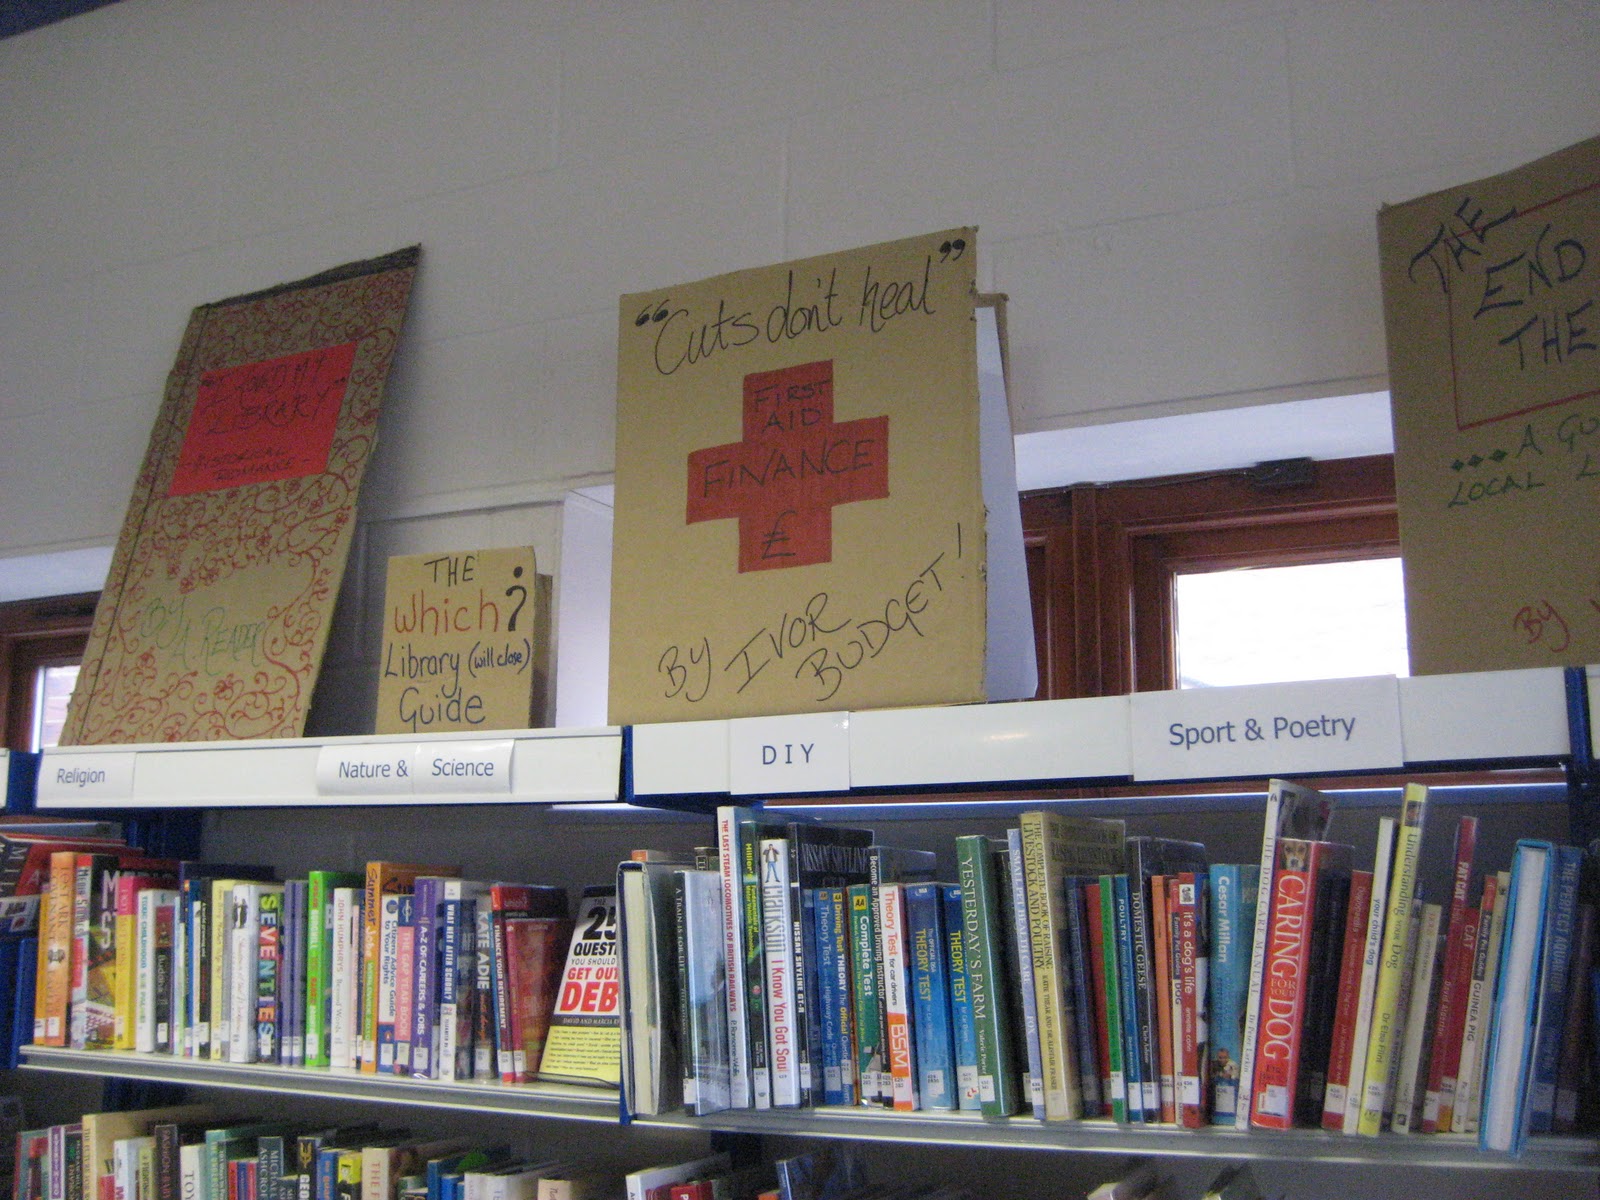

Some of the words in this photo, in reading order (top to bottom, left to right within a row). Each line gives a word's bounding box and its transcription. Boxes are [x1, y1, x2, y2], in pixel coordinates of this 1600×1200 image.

[1473, 223, 1587, 320] END
[1498, 300, 1598, 371] THE
[753, 379, 832, 412] FIRST
[762, 409, 822, 434] AID
[704, 439, 875, 498] FINANCE
[1449, 472, 1545, 508] LOCAL
[424, 556, 475, 587] THE
[385, 642, 460, 699] Library
[400, 686, 486, 733] Guide
[1169, 721, 1236, 750] Sport
[1245, 718, 1264, 741] &
[1274, 714, 1355, 741] Poetry
[57, 767, 106, 787] Religion
[339, 760, 392, 779] Nature
[396, 760, 409, 779] &
[431, 757, 495, 777] Science
[721, 820, 730, 833] THE
[1033, 820, 1043, 840] THE
[721, 834, 731, 852] LAST
[1023, 821, 1037, 887] LIVESTOCK
[1263, 837, 1274, 861] THE
[722, 854, 732, 877] STEAM
[868, 855, 878, 885] Become
[1011, 849, 1022, 885] SMALL
[1034, 842, 1048, 890] COMPLETE
[1260, 867, 1271, 895] DOG
[1395, 833, 1418, 916] Understanding
[337, 898, 345, 921] JOHN
[366, 867, 378, 926] Summer
[724, 879, 734, 930] LOCOMOTIVES
[751, 885, 759, 928] Fundamentals
[885, 892, 897, 930] Theory
[1027, 889, 1040, 915] AND
[1039, 892, 1050, 917] BOOK
[1217, 875, 1229, 916] Cesar
[1372, 898, 1382, 917] your
[446, 903, 455, 924] WHAT
[820, 905, 831, 942] Theory
[834, 904, 843, 934] Driving
[871, 898, 882, 933] Approved
[1118, 898, 1127, 942] POULTRY
[1131, 892, 1145, 952] DOMESTIC
[1183, 912, 1194, 928] it's
[1256, 900, 1268, 934] CARE
[1271, 874, 1306, 979] CARING
[390, 919, 398, 955] Citizens
[401, 932, 410, 952] THE
[477, 911, 490, 948] KATE
[494, 925, 503, 957] FINANCE
[793, 922, 801, 954] NISSAN
[859, 915, 871, 967] Complete
[887, 932, 898, 956] Test
[960, 856, 982, 969] YESTERDAY'S
[972, 974, 987, 1020] FARM
[1017, 909, 1027, 954] HEALTH
[1031, 918, 1045, 970] POULTRY
[1217, 918, 1230, 964] Millan
[1369, 919, 1380, 946] child's
[1462, 924, 1476, 950] CAT
[335, 924, 345, 973] HUMPHRYS
[571, 957, 586, 965] YOU
[588, 957, 616, 965] SHOULD
[573, 942, 616, 956] QUESTI
[726, 943, 735, 971] BRITISH
[822, 944, 833, 966] Test
[873, 934, 884, 961] Driving
[914, 928, 928, 972] THEORY
[949, 930, 962, 973] THEORY
[1042, 933, 1055, 970] RAISING
[1182, 941, 1195, 974] dog's
[1365, 948, 1376, 966] dog
[1386, 943, 1401, 969] Dog
[258, 894, 278, 1037] SEVENTIES
[383, 956, 391, 985] Rights
[401, 954, 409, 974] GAP
[477, 951, 490, 989] ADIE
[567, 967, 591, 980] GET
[595, 967, 619, 980] OUT
[795, 956, 803, 992] SKYLINE
[837, 954, 847, 992] THEORY
[1021, 955, 1030, 985] CARE
[1135, 954, 1147, 990] GEESE
[1250, 940, 1264, 996] MANUAL
[400, 976, 409, 1004] YEAR
[418, 959, 427, 1001] CAREERS
[728, 973, 737, 1012] RAILWAYS
[771, 967, 785, 999] Know
[862, 971, 873, 996] Test
[876, 963, 886, 1000] Instructor
[890, 981, 899, 1006] drivers
[918, 975, 931, 1001] TEST
[953, 977, 966, 1003] TEST
[1184, 976, 1195, 994] life
[1270, 979, 1296, 989] FOR
[389, 986, 397, 1016] Guide
[497, 980, 507, 1029] RETIREMENT
[560, 981, 619, 1012] DEB
[1468, 982, 1482, 1023] GUINEA
[400, 1006, 409, 1036] BOOK
[417, 1012, 426, 1035] JOBS
[773, 1002, 786, 1023] You
[840, 1006, 849, 1034] Official
[1026, 1015, 1036, 1035] FOX
[775, 1026, 788, 1044] Got
[1263, 998, 1295, 1059] DOG
[1466, 1024, 1478, 1042] PIG
[776, 1048, 789, 1072] Soul
[891, 1024, 909, 1068] BSM
[184, 1170, 194, 1200] TOY
[260, 1147, 268, 1198] ASHCROF
